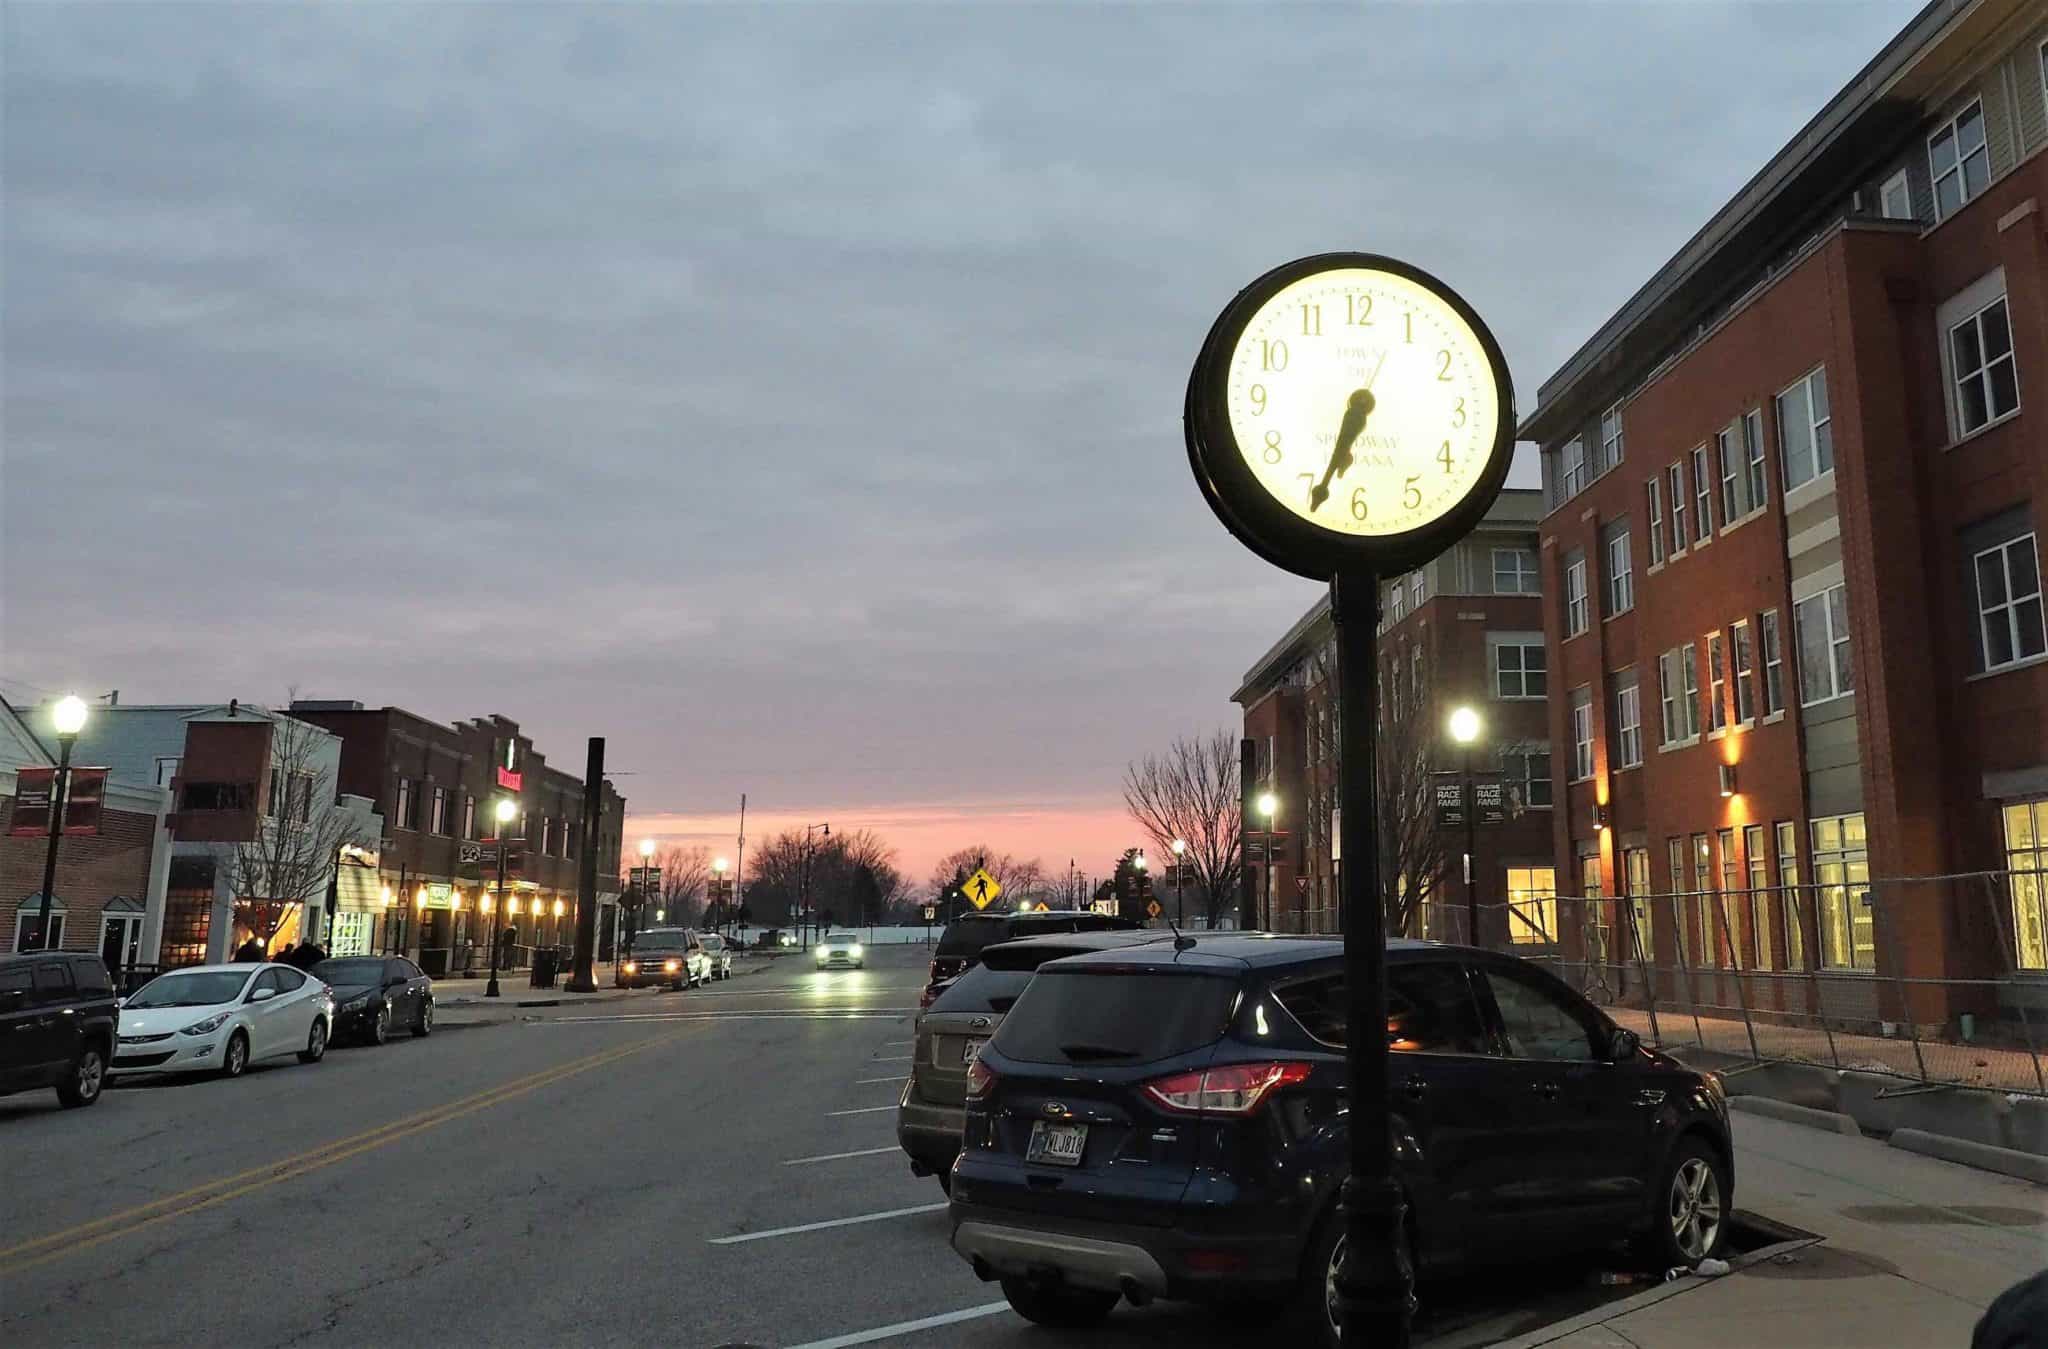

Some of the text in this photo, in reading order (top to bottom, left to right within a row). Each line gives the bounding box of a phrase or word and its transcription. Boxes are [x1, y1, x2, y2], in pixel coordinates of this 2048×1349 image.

[1301, 304, 1323, 336] 11
[1345, 295, 1374, 326] 12
[1403, 312, 1413, 344] 1
[1260, 339, 1289, 372] 10
[1436, 350, 1454, 382] 2
[1250, 384, 1267, 416] 9
[1452, 397, 1466, 428] 3
[1263, 430, 1282, 464] 8
[1315, 431, 1400, 449] SPDWAY
[1323, 450, 1395, 468] IIANA
[1436, 440, 1455, 473] 4
[1297, 473, 1316, 506] 7
[1351, 487, 1367, 520] 6
[1403, 475, 1422, 509] 5
[1437, 790, 1461, 799] RACE
[1477, 790, 1501, 798] RACE
